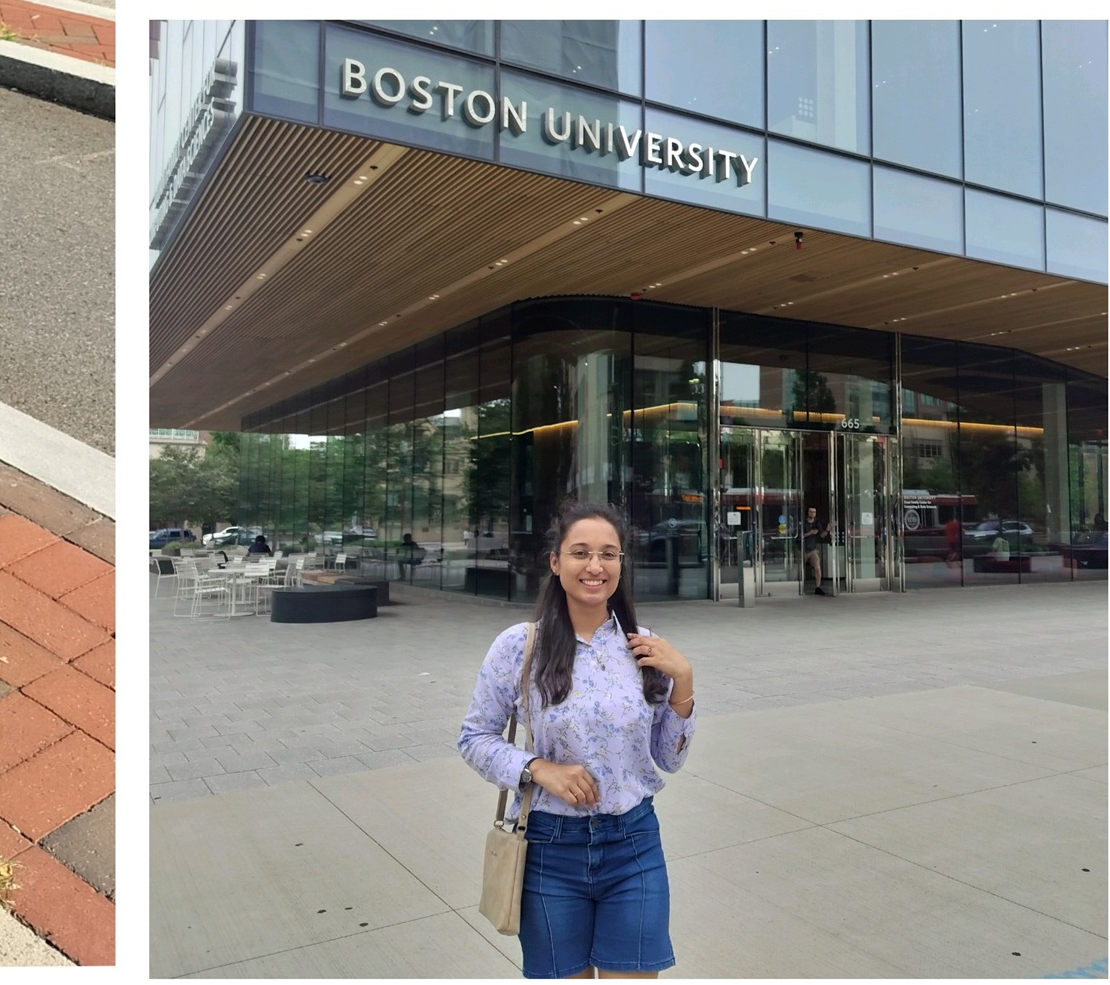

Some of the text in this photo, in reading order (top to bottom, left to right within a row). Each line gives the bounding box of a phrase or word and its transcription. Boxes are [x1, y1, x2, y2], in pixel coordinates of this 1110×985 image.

[343, 57, 758, 186] BOSTON UNIVERSITY
[841, 418, 860, 430] 665
